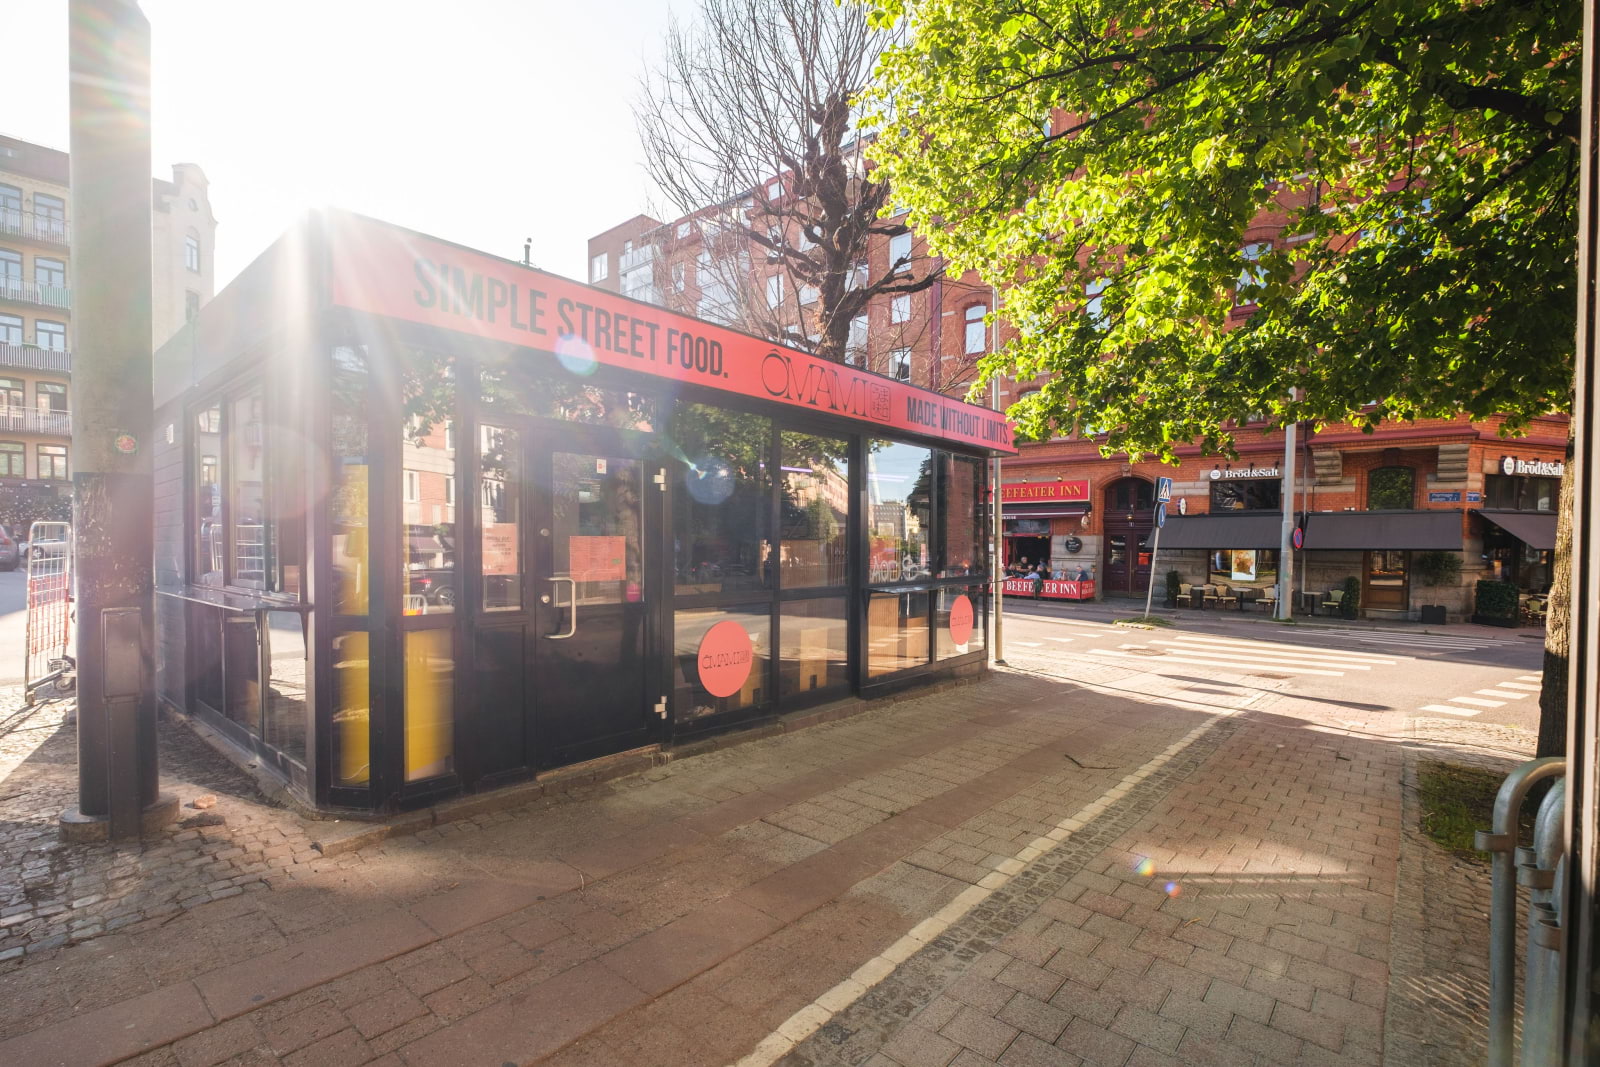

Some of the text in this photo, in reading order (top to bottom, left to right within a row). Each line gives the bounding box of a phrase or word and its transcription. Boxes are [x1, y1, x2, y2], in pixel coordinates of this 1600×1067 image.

[413, 257, 729, 379] SIMPLE STREET FOOD.
[907, 396, 1010, 446] MADE WITHOUT LIMITS.
[1001, 485, 1081, 498] EEFEATER INN
[1060, 583, 1077, 594] INN
